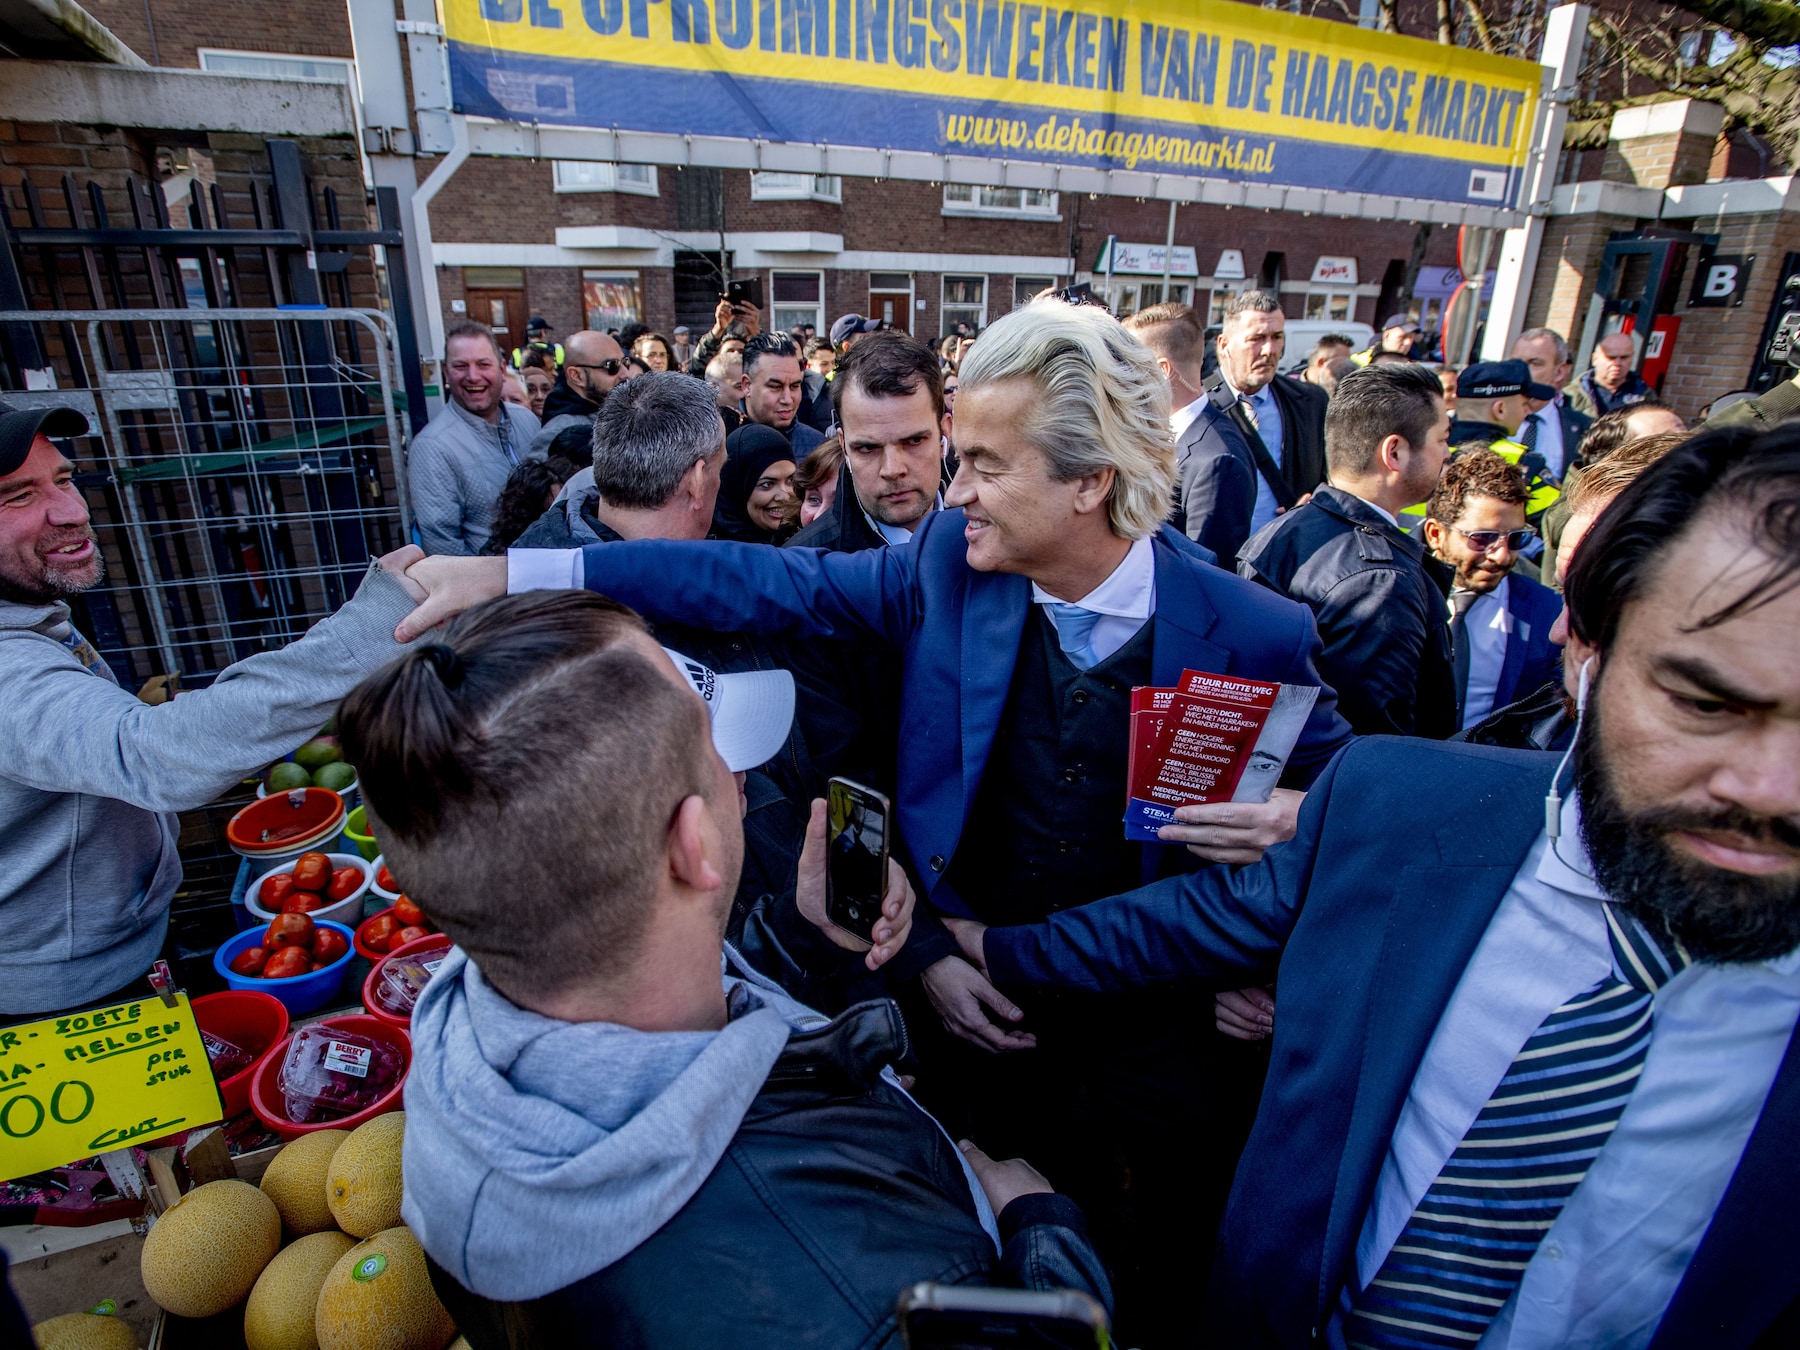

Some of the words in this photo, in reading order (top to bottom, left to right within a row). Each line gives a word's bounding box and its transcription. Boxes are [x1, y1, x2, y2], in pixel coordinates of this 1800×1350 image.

[1141, 22, 1220, 104] VAN
[1225, 39, 1276, 113] DE
[1281, 49, 1416, 134] HAAGSE
[1416, 75, 1526, 148] MARKT
[947, 114, 1276, 174] www.dehaagsemarkt.nl
[1702, 264, 1739, 298] B
[1191, 676, 1222, 687] STUUR
[1222, 681, 1251, 692] RUTTE
[1252, 686, 1273, 696] WEG
[1187, 704, 1219, 715] GRENZEN
[1185, 710, 1202, 718] WEG
[1202, 713, 1217, 721] MET
[1217, 716, 1258, 728] MARRAKESH
[1192, 719, 1219, 729] MINDER
[1219, 723, 1240, 732] ISLAM
[1177, 729, 1196, 737] GEEN
[1197, 732, 1224, 743] HOGERE
[1169, 747, 1230, 764] KLIMAATAKKOORD
[1189, 744, 1204, 752] MET
[1165, 759, 1184, 767] GEEN
[1184, 763, 1202, 771] GELD
[1202, 767, 1222, 775] NAAR
[1158, 776, 1180, 785] MAAR
[1180, 781, 1200, 789] NAAR
[1170, 772, 1215, 786] ASIELZOEKERS
[1188, 770, 1215, 780] BRUSSEL
[1152, 791, 1171, 800] WEER
[1153, 786, 1207, 801] NEDERLANDERS
[1143, 807, 1170, 818] STEM
[55, 1004, 141, 1035] ZOETE
[64, 1021, 181, 1061] MELOEN
[335, 1043, 365, 1057] BERRY
[147, 1048, 187, 1071] PER
[146, 1064, 191, 1086] STUK
